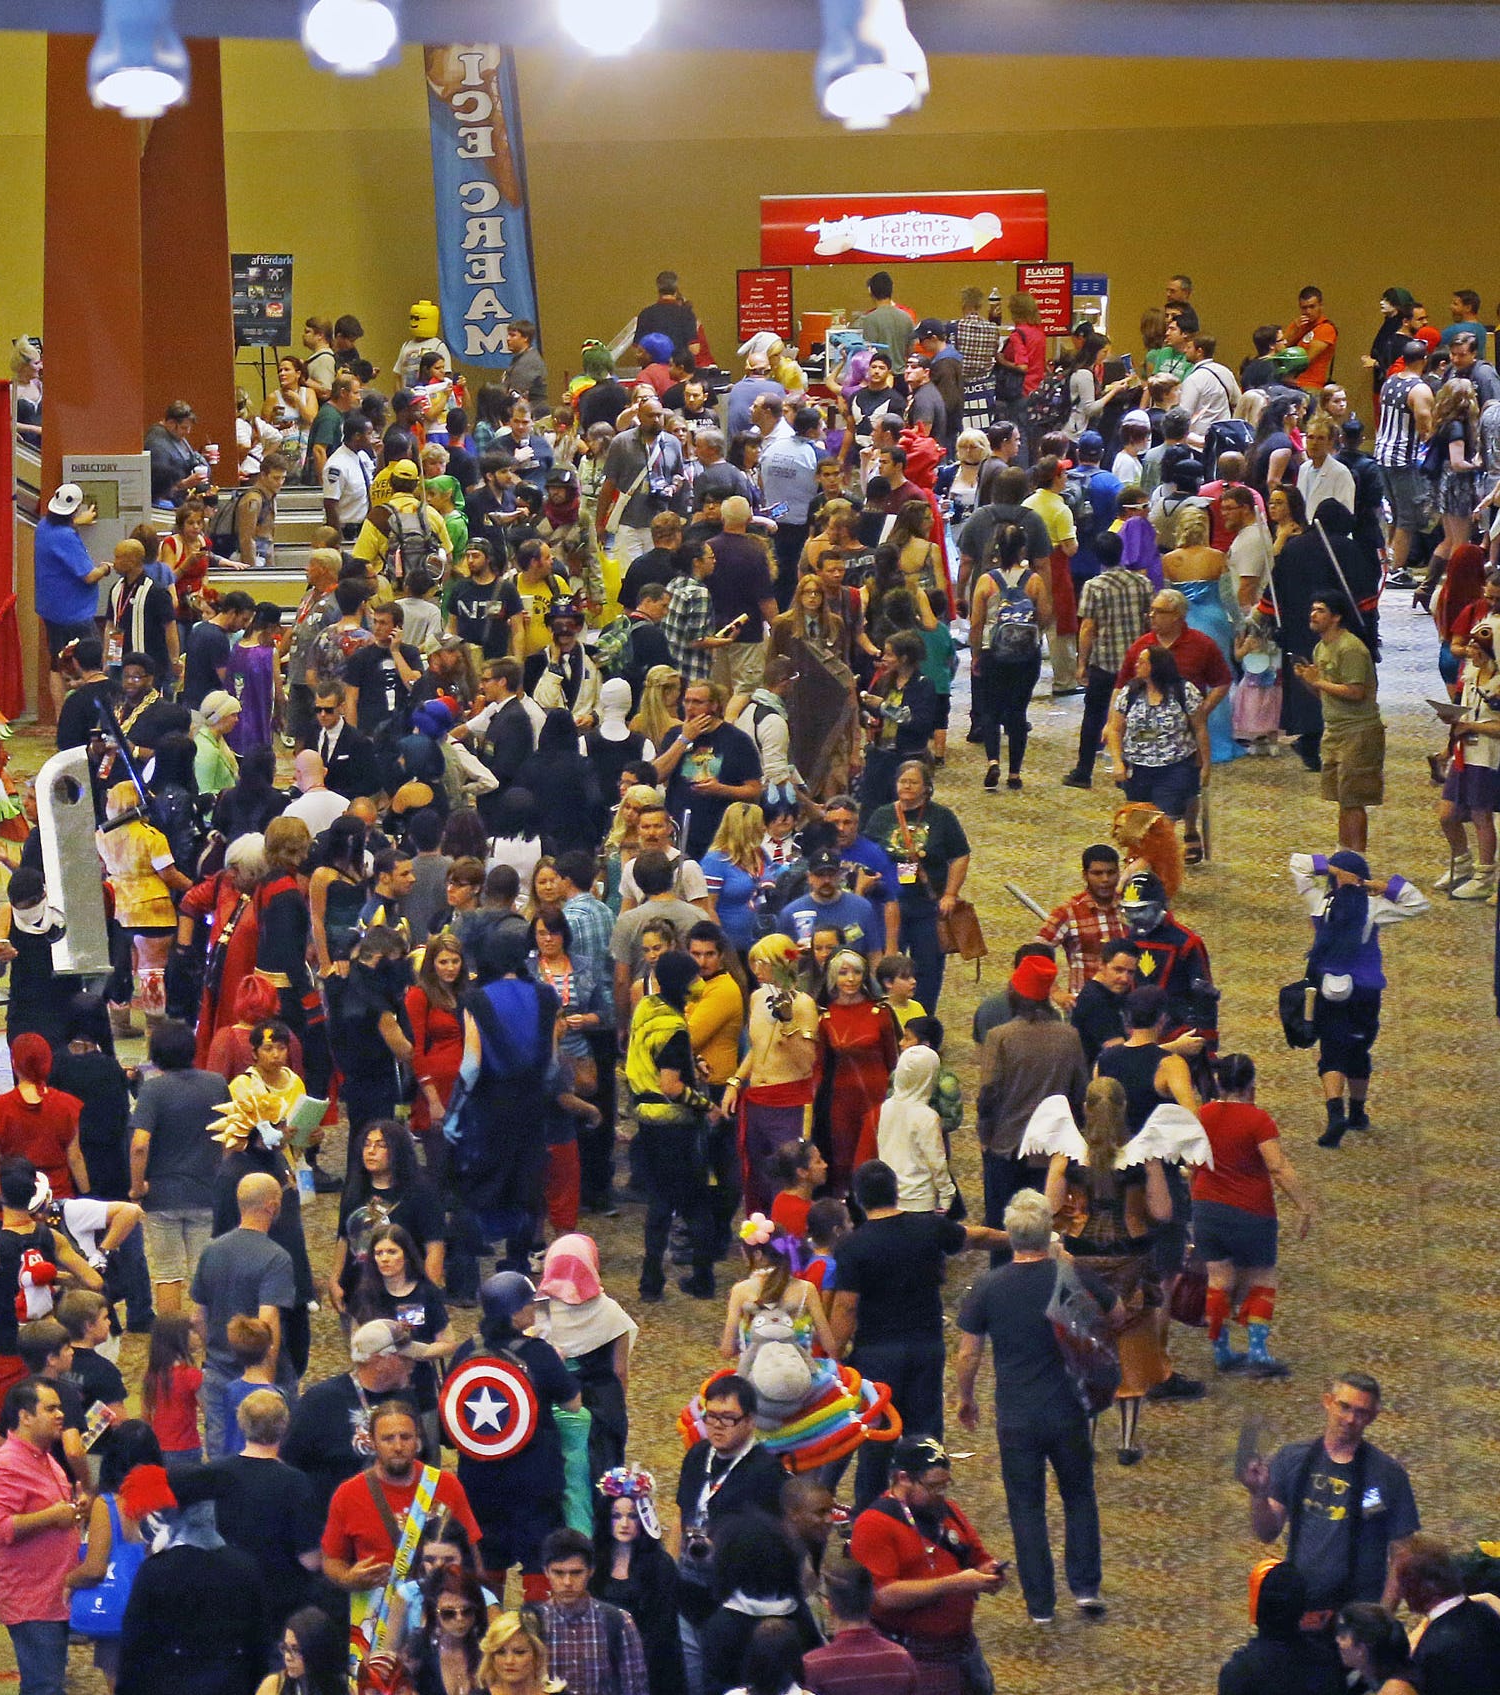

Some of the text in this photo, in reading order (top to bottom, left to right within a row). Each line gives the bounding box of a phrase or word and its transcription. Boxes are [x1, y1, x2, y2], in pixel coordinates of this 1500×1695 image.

[881, 218, 950, 233] Karen's
[870, 233, 961, 249] Kreamery
[1025, 267, 1065, 276] FLAVORS
[71, 464, 118, 472] DIRECTORY
